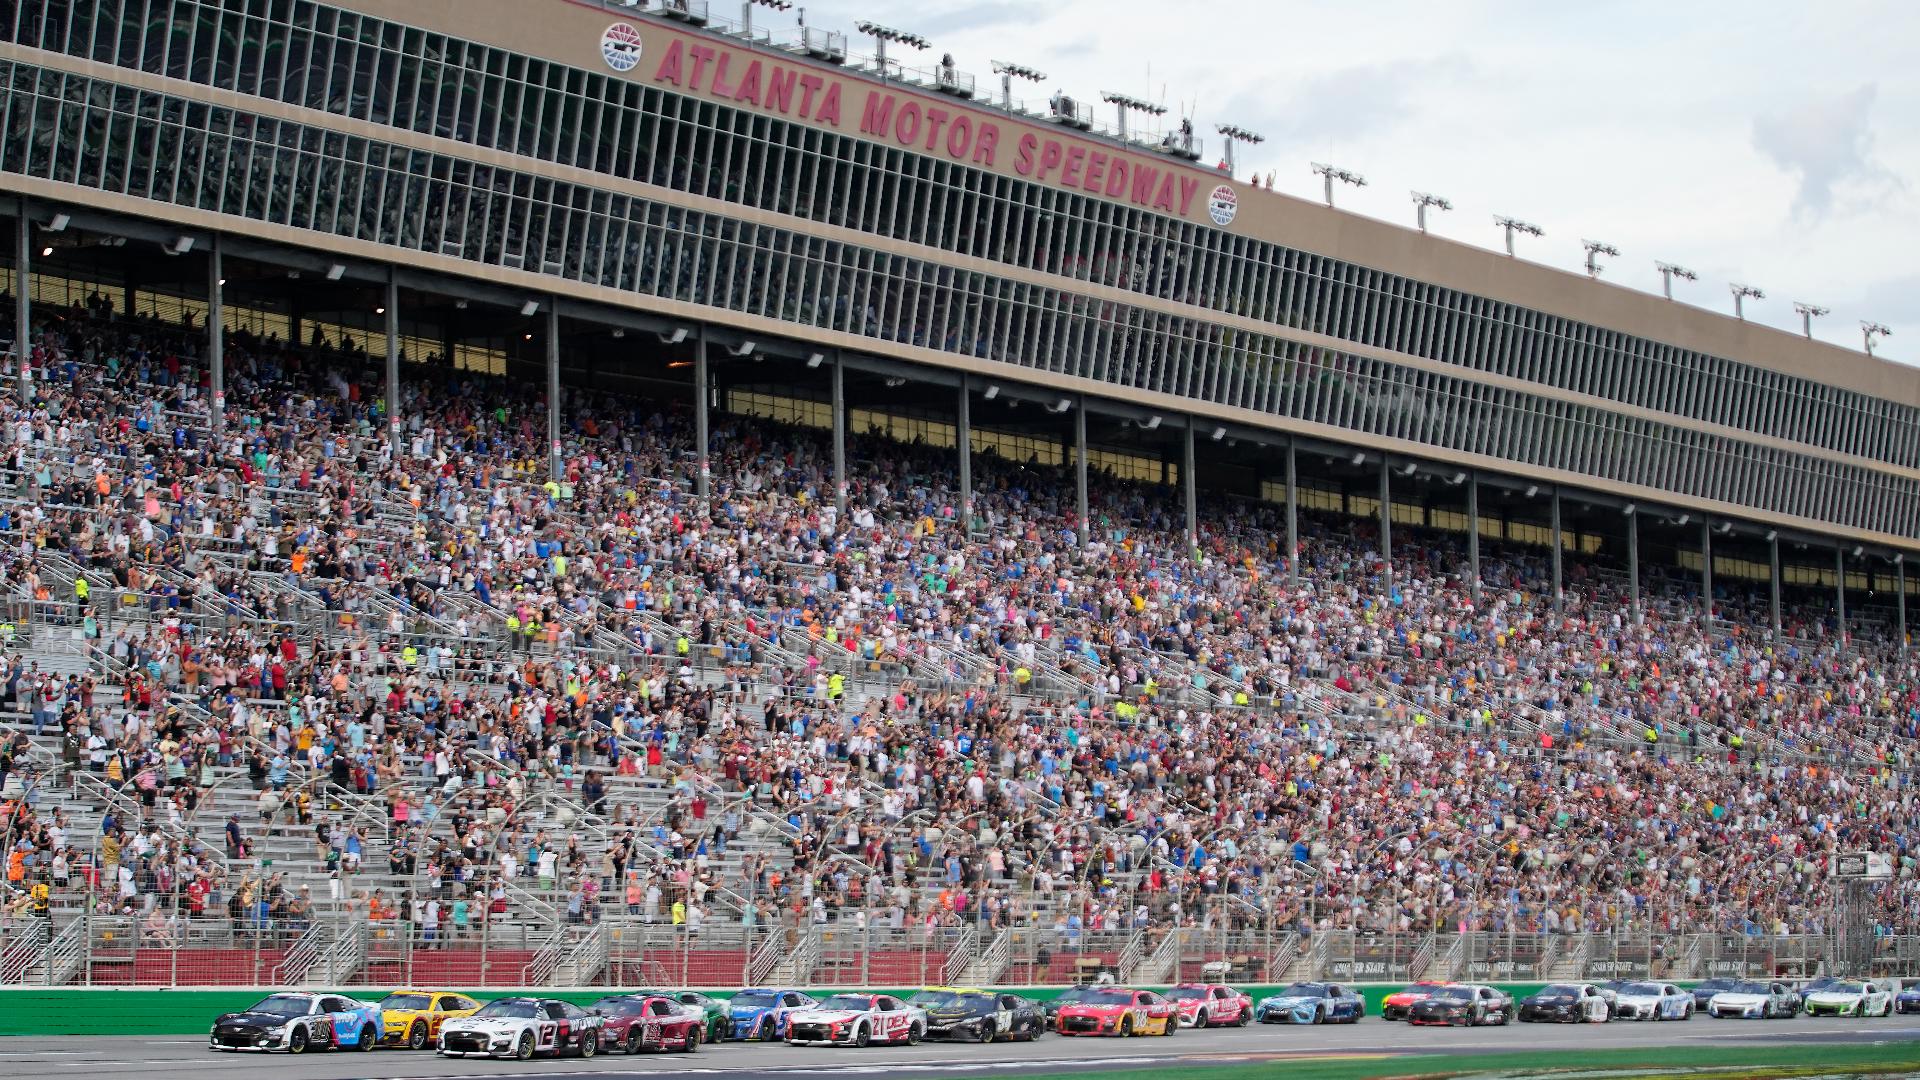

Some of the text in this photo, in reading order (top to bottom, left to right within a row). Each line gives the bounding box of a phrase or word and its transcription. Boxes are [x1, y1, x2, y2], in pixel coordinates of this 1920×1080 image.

[655, 39, 1200, 216] ATLANTA MOTOR SPEEDWAY
[1334, 962, 1364, 974] QUAER
[1365, 962, 1386, 973] STATE
[538, 1022, 557, 1046] 12
[872, 1014, 884, 1036] 21
